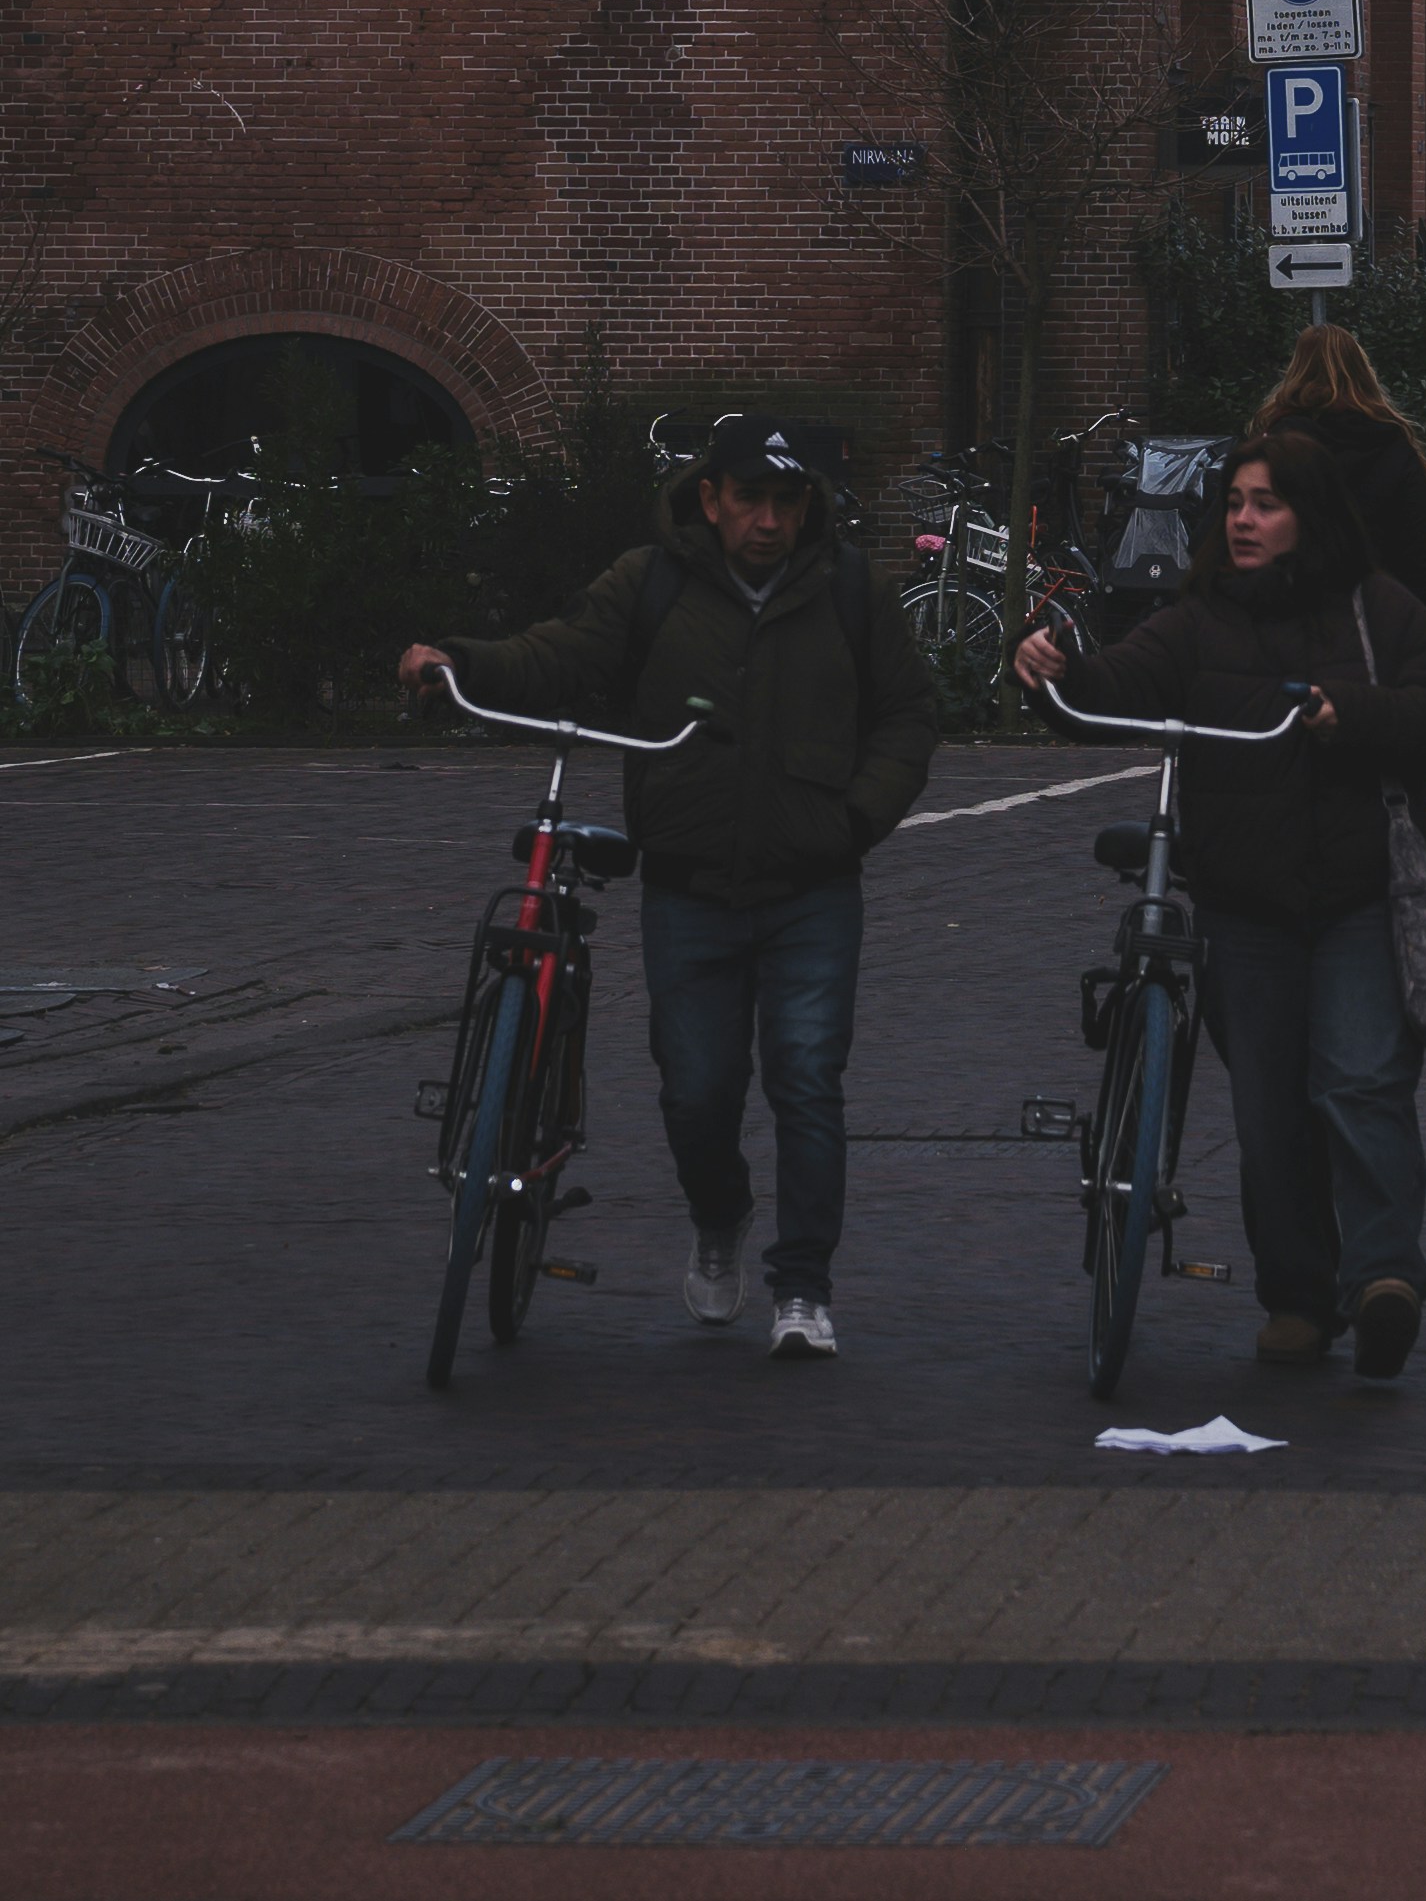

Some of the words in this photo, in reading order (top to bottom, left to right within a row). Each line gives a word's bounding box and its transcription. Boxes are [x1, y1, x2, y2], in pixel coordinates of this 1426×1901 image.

[1274, 9, 1331, 20] toegestaan
[1266, 22, 1295, 31] laden
[1307, 20, 1340, 29] lossen
[1280, 32, 1299, 42] t/m
[1303, 32, 1318, 40] za.
[1345, 30, 1351, 38] h
[1258, 46, 1277, 54] ma.
[1281, 45, 1301, 53] t/m
[1304, 44, 1319, 52] zo.
[1323, 41, 1341, 51] 9-11
[1344, 41, 1351, 50] h
[1284, 78, 1324, 138] P
[1280, 194, 1337, 206] uitsluitend
[1291, 210, 1327, 220] bussen
[1301, 222, 1348, 234] zwembad
